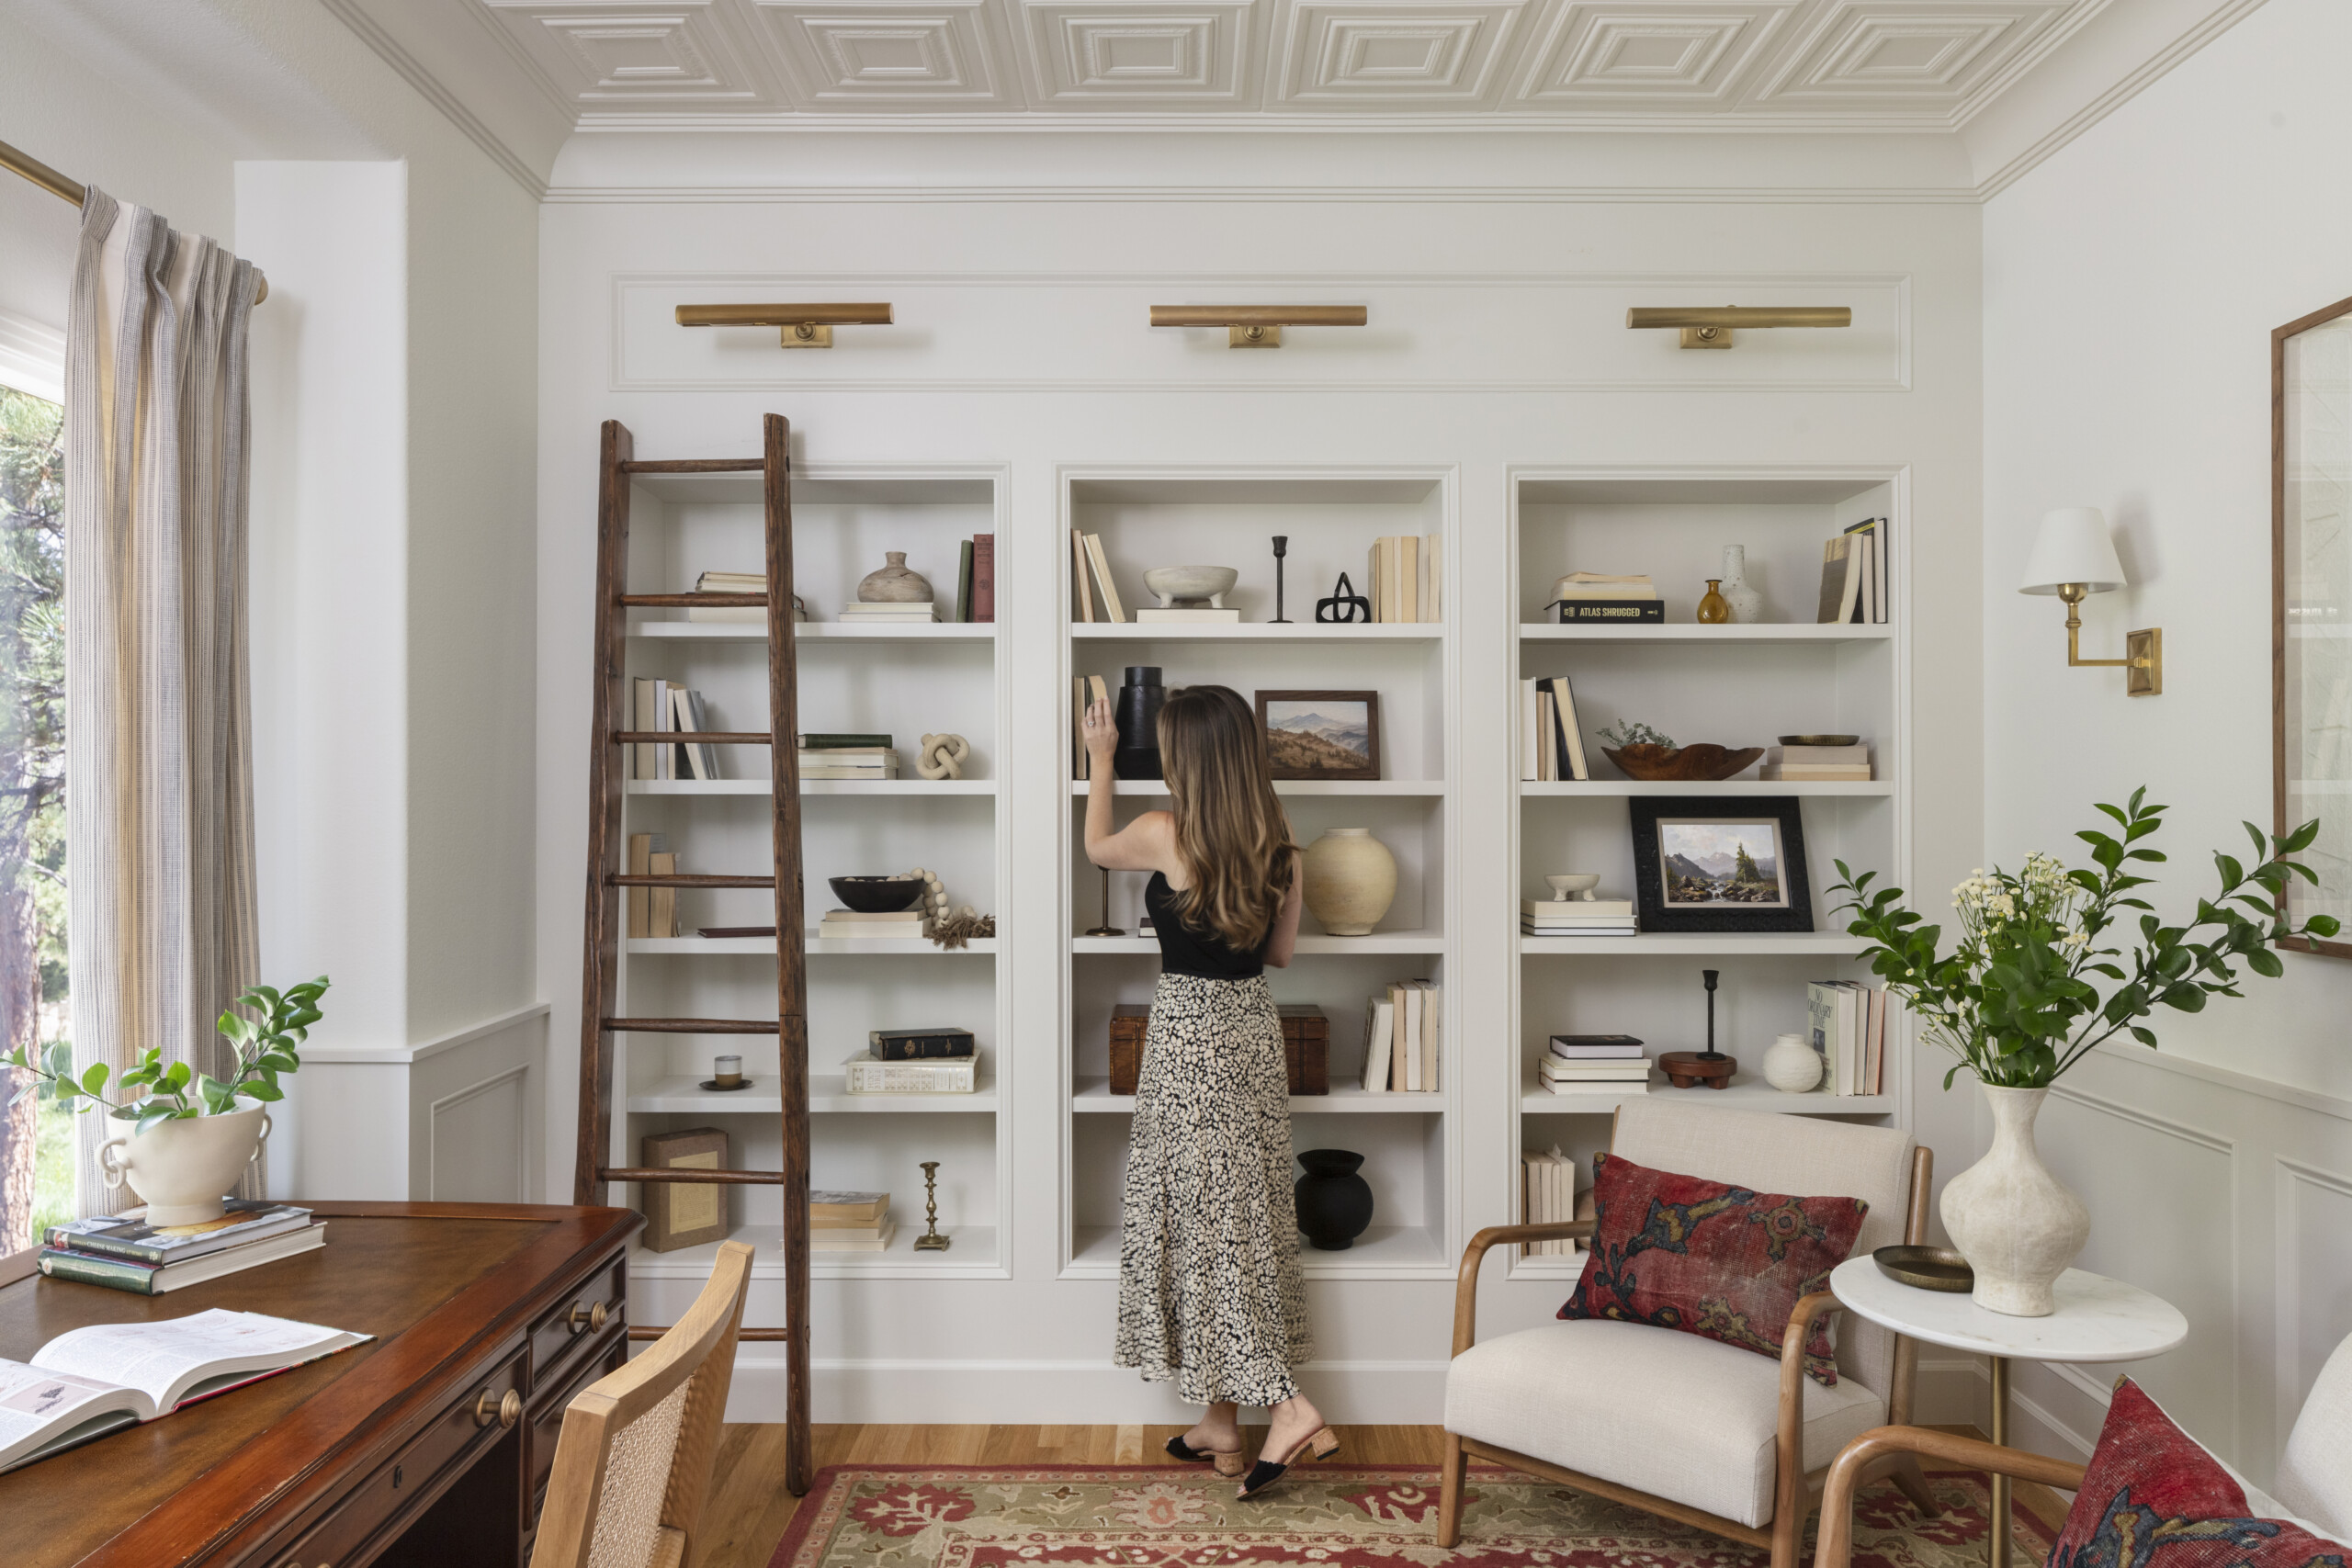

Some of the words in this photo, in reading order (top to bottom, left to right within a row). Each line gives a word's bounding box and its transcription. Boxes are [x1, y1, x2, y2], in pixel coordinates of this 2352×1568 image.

[1579, 607, 1600, 616] ATLAS
[1601, 607, 1641, 617] SHRUGGED
[1815, 988, 1823, 1003] NO
[1808, 998, 1832, 1018] ORDINARY
[86, 1241, 106, 1250] CHEESE
[106, 1244, 126, 1254] MAKING
